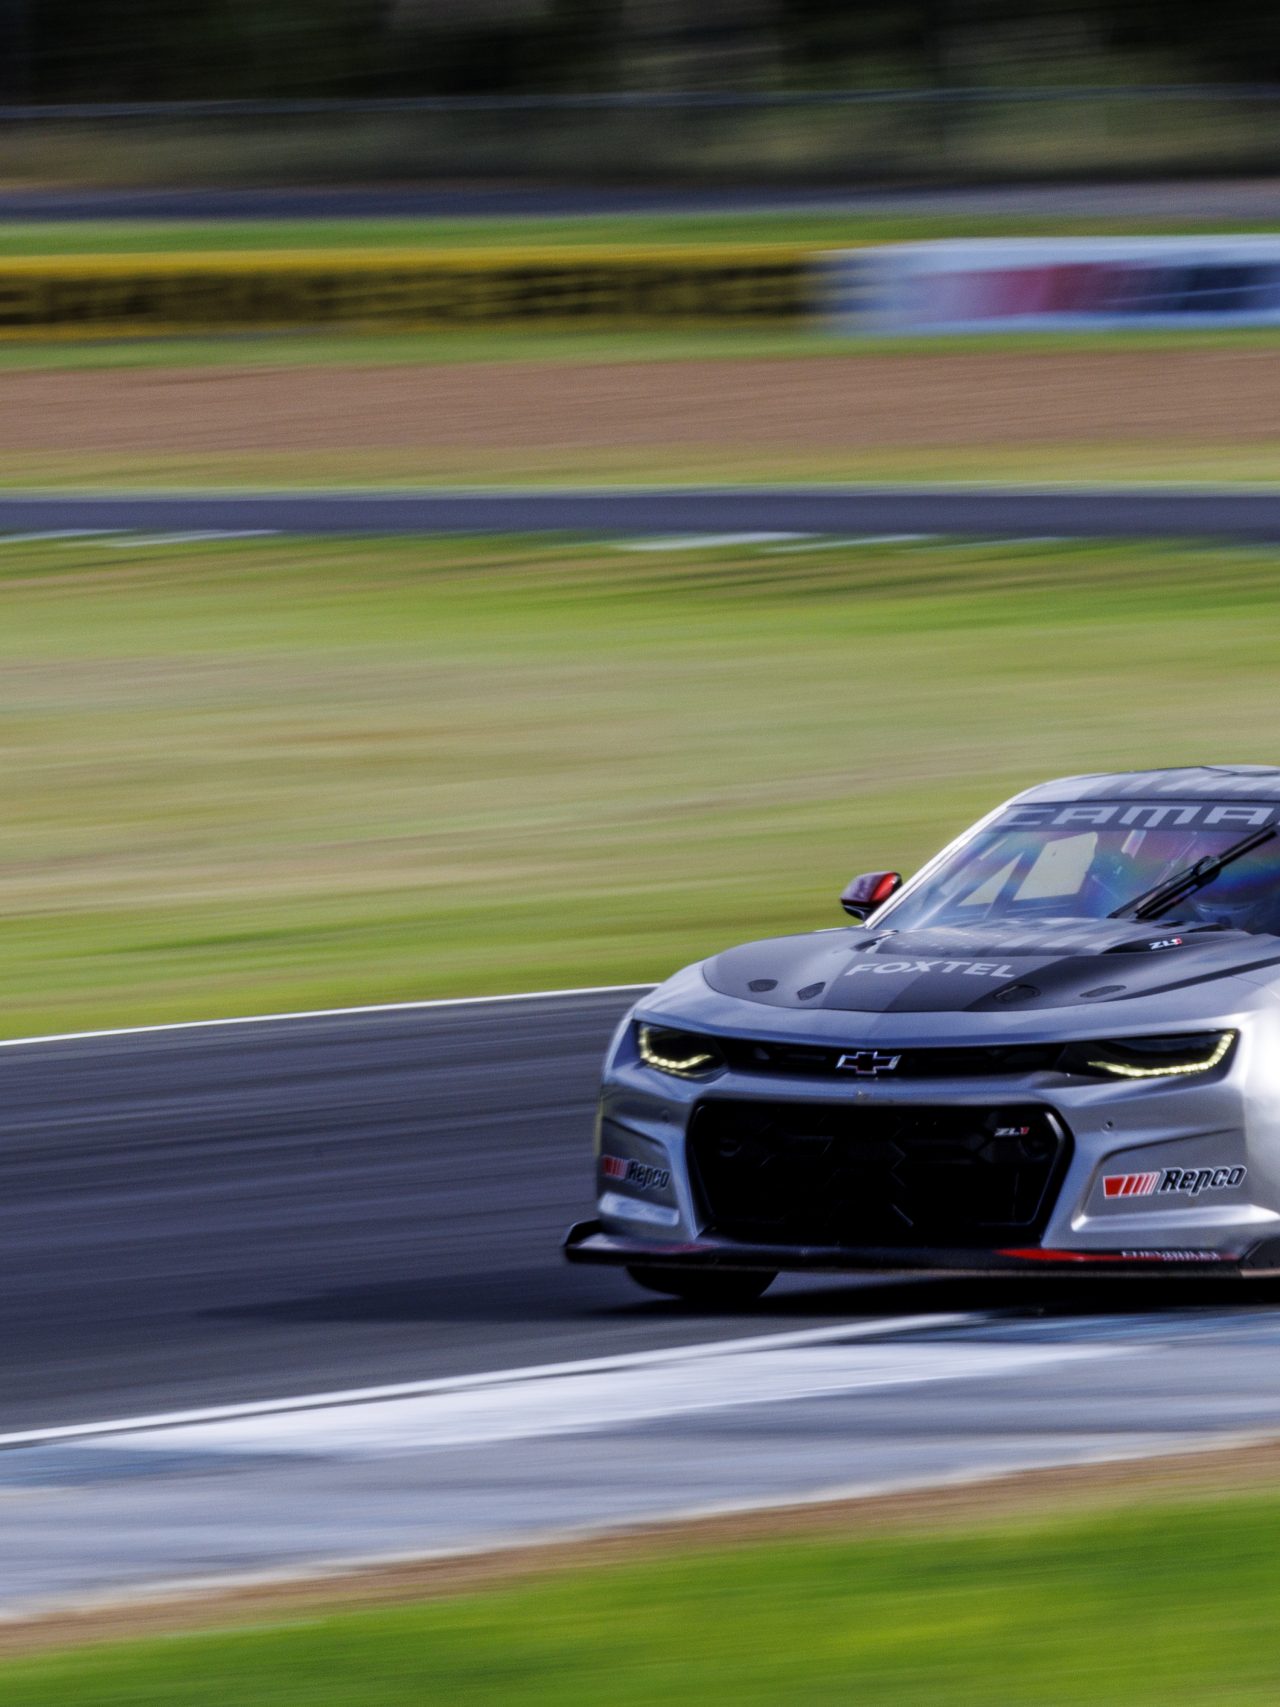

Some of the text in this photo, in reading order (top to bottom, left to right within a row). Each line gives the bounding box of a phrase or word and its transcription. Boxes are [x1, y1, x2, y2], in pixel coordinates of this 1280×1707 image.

[844, 960, 1015, 978] FOXTEL
[627, 1159, 672, 1189] Repco
[1159, 1166, 1247, 1195] Repco
